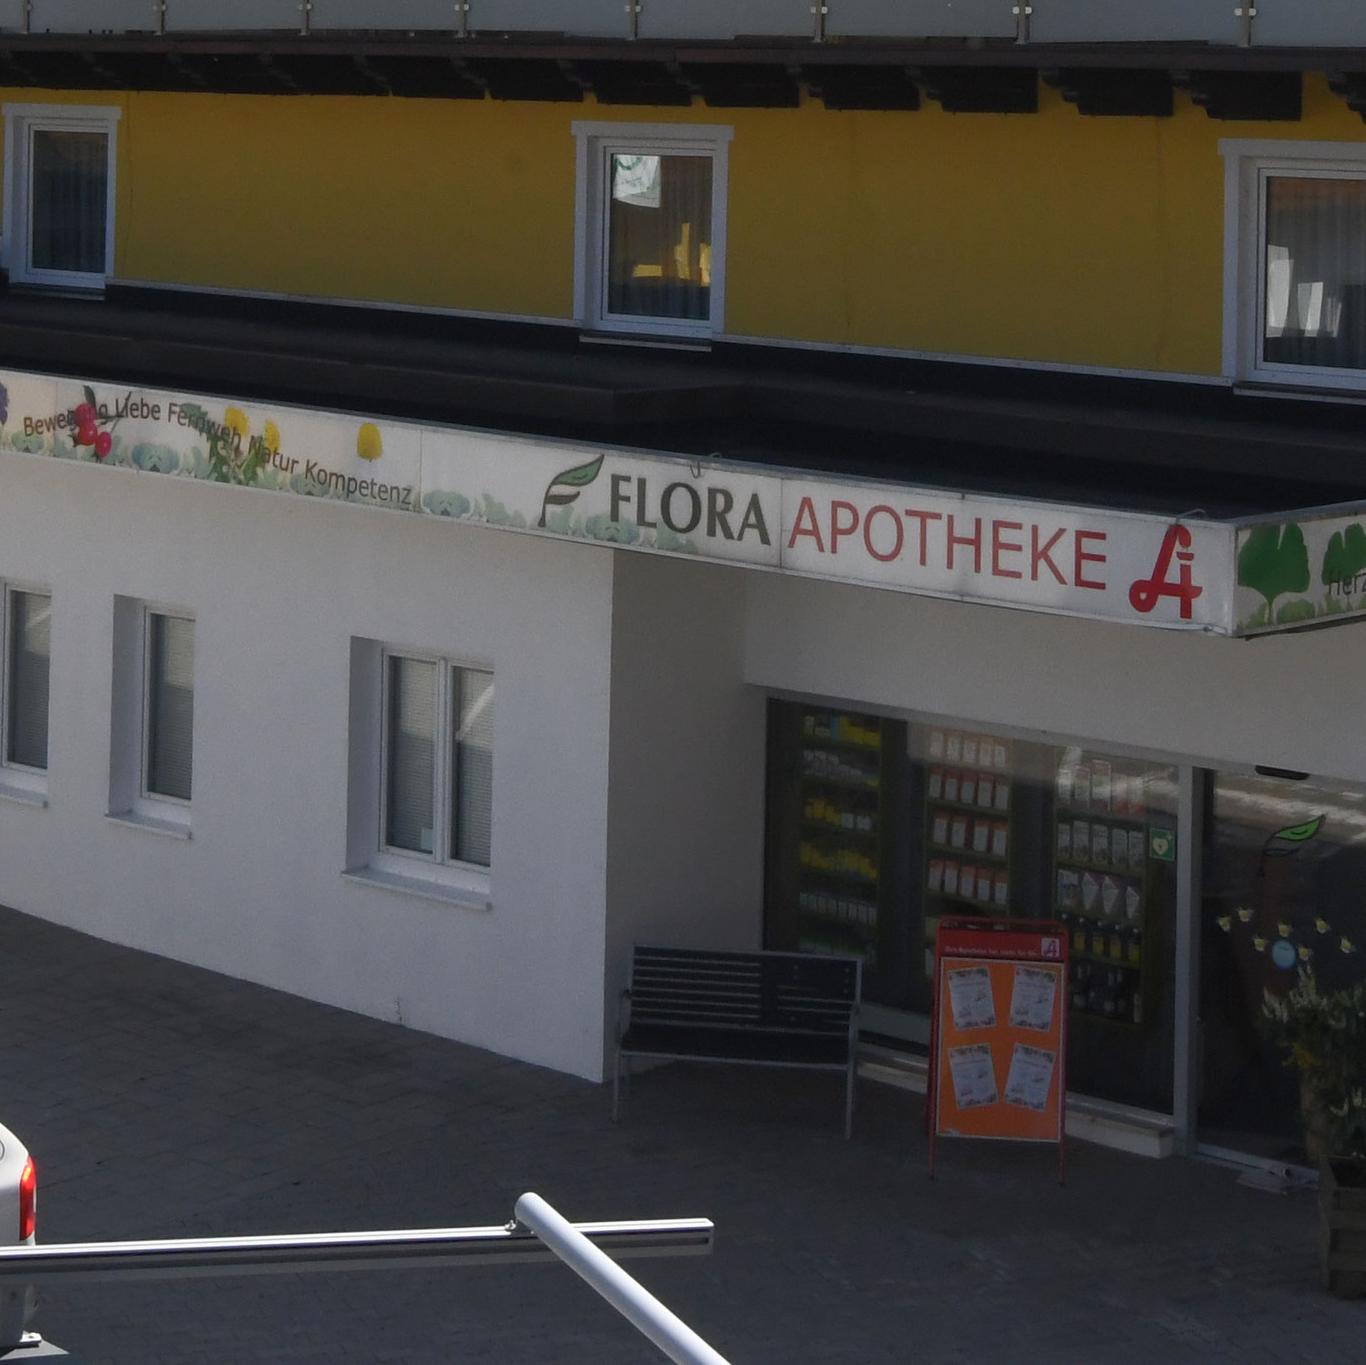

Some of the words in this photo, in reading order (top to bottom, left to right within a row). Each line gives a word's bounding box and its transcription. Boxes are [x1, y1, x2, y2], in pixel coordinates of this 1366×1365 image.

[23, 403, 108, 436] Bewegg
[115, 398, 161, 421] Liebe
[305, 459, 412, 505] Kompetenz
[610, 473, 771, 546] FLORA
[787, 496, 1107, 590] APOTHEKE
